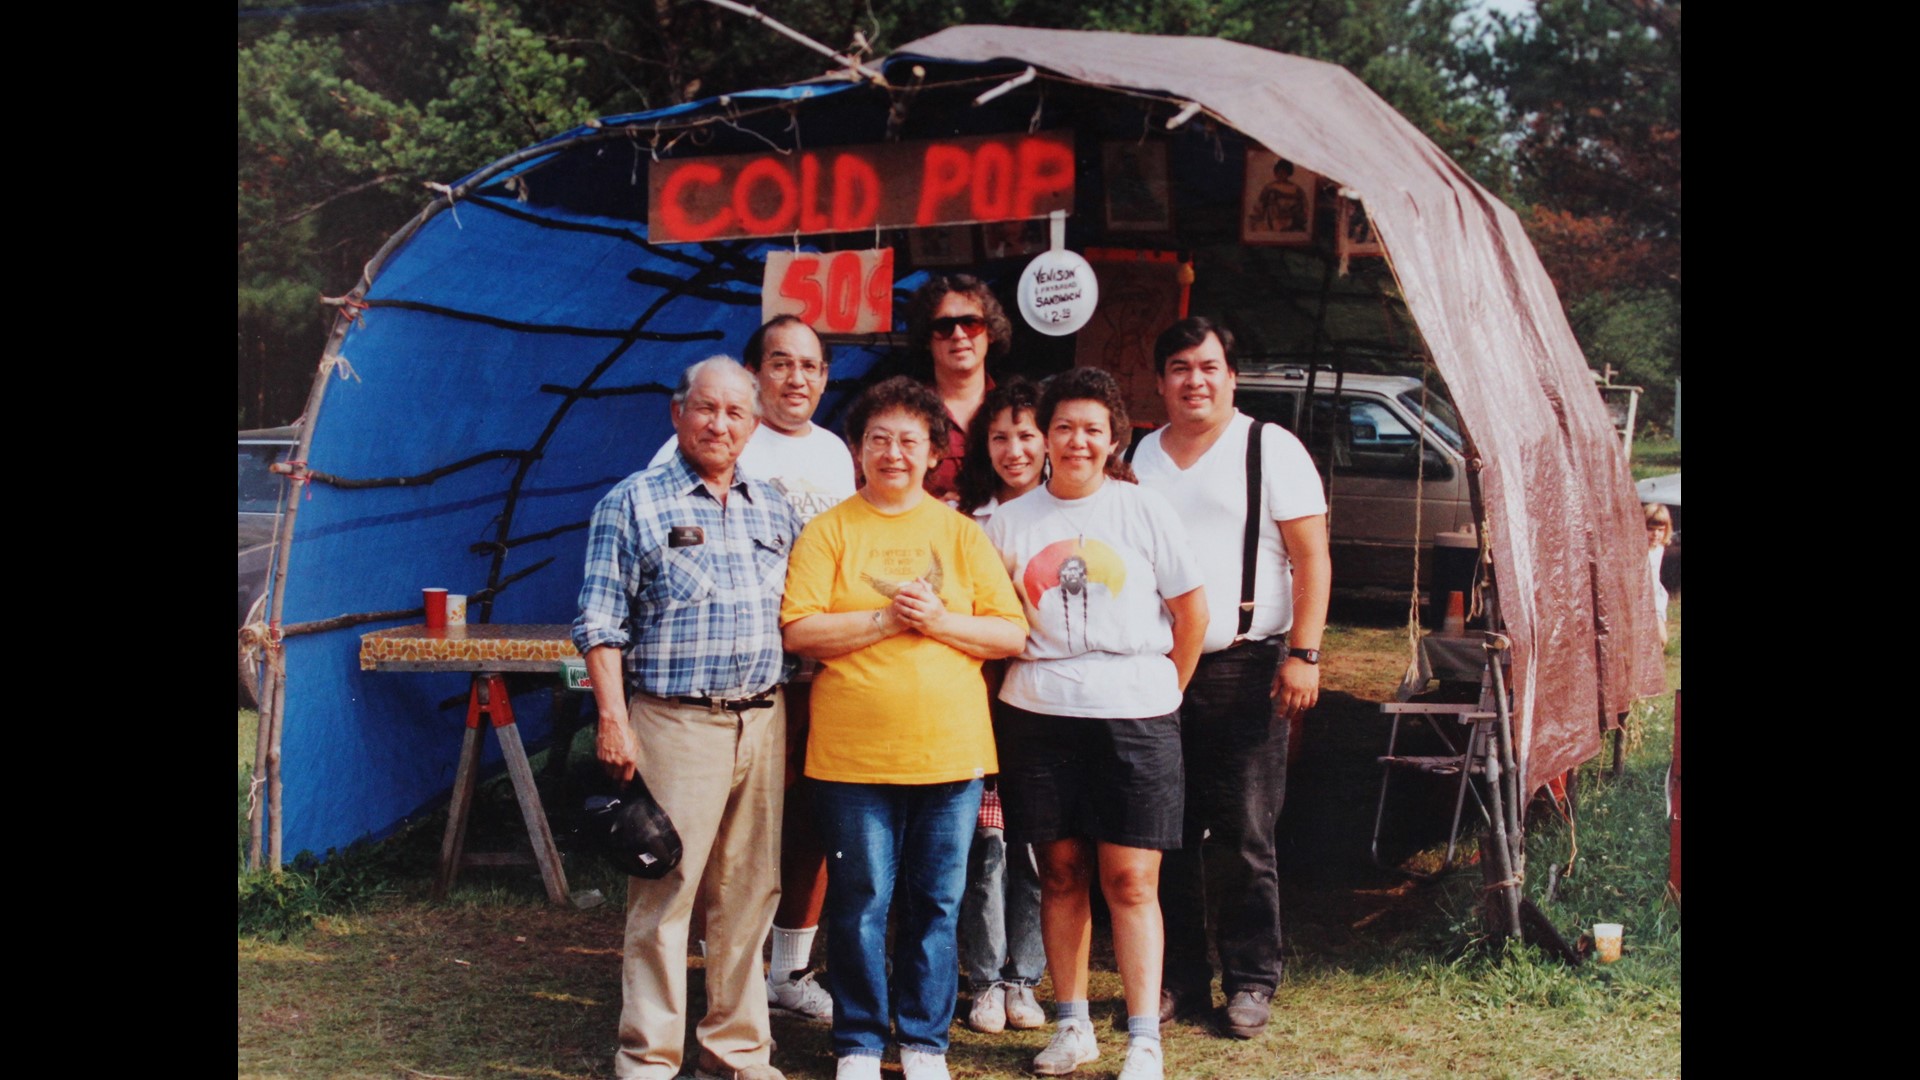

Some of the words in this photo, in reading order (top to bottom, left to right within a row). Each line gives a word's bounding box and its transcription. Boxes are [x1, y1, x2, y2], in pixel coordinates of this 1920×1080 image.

[660, 152, 881, 242] COLD
[915, 137, 1075, 227] POP
[1033, 266, 1077, 285] VENISON
[1035, 289, 1082, 308] SANDWICH
[789, 491, 841, 514] RAN
